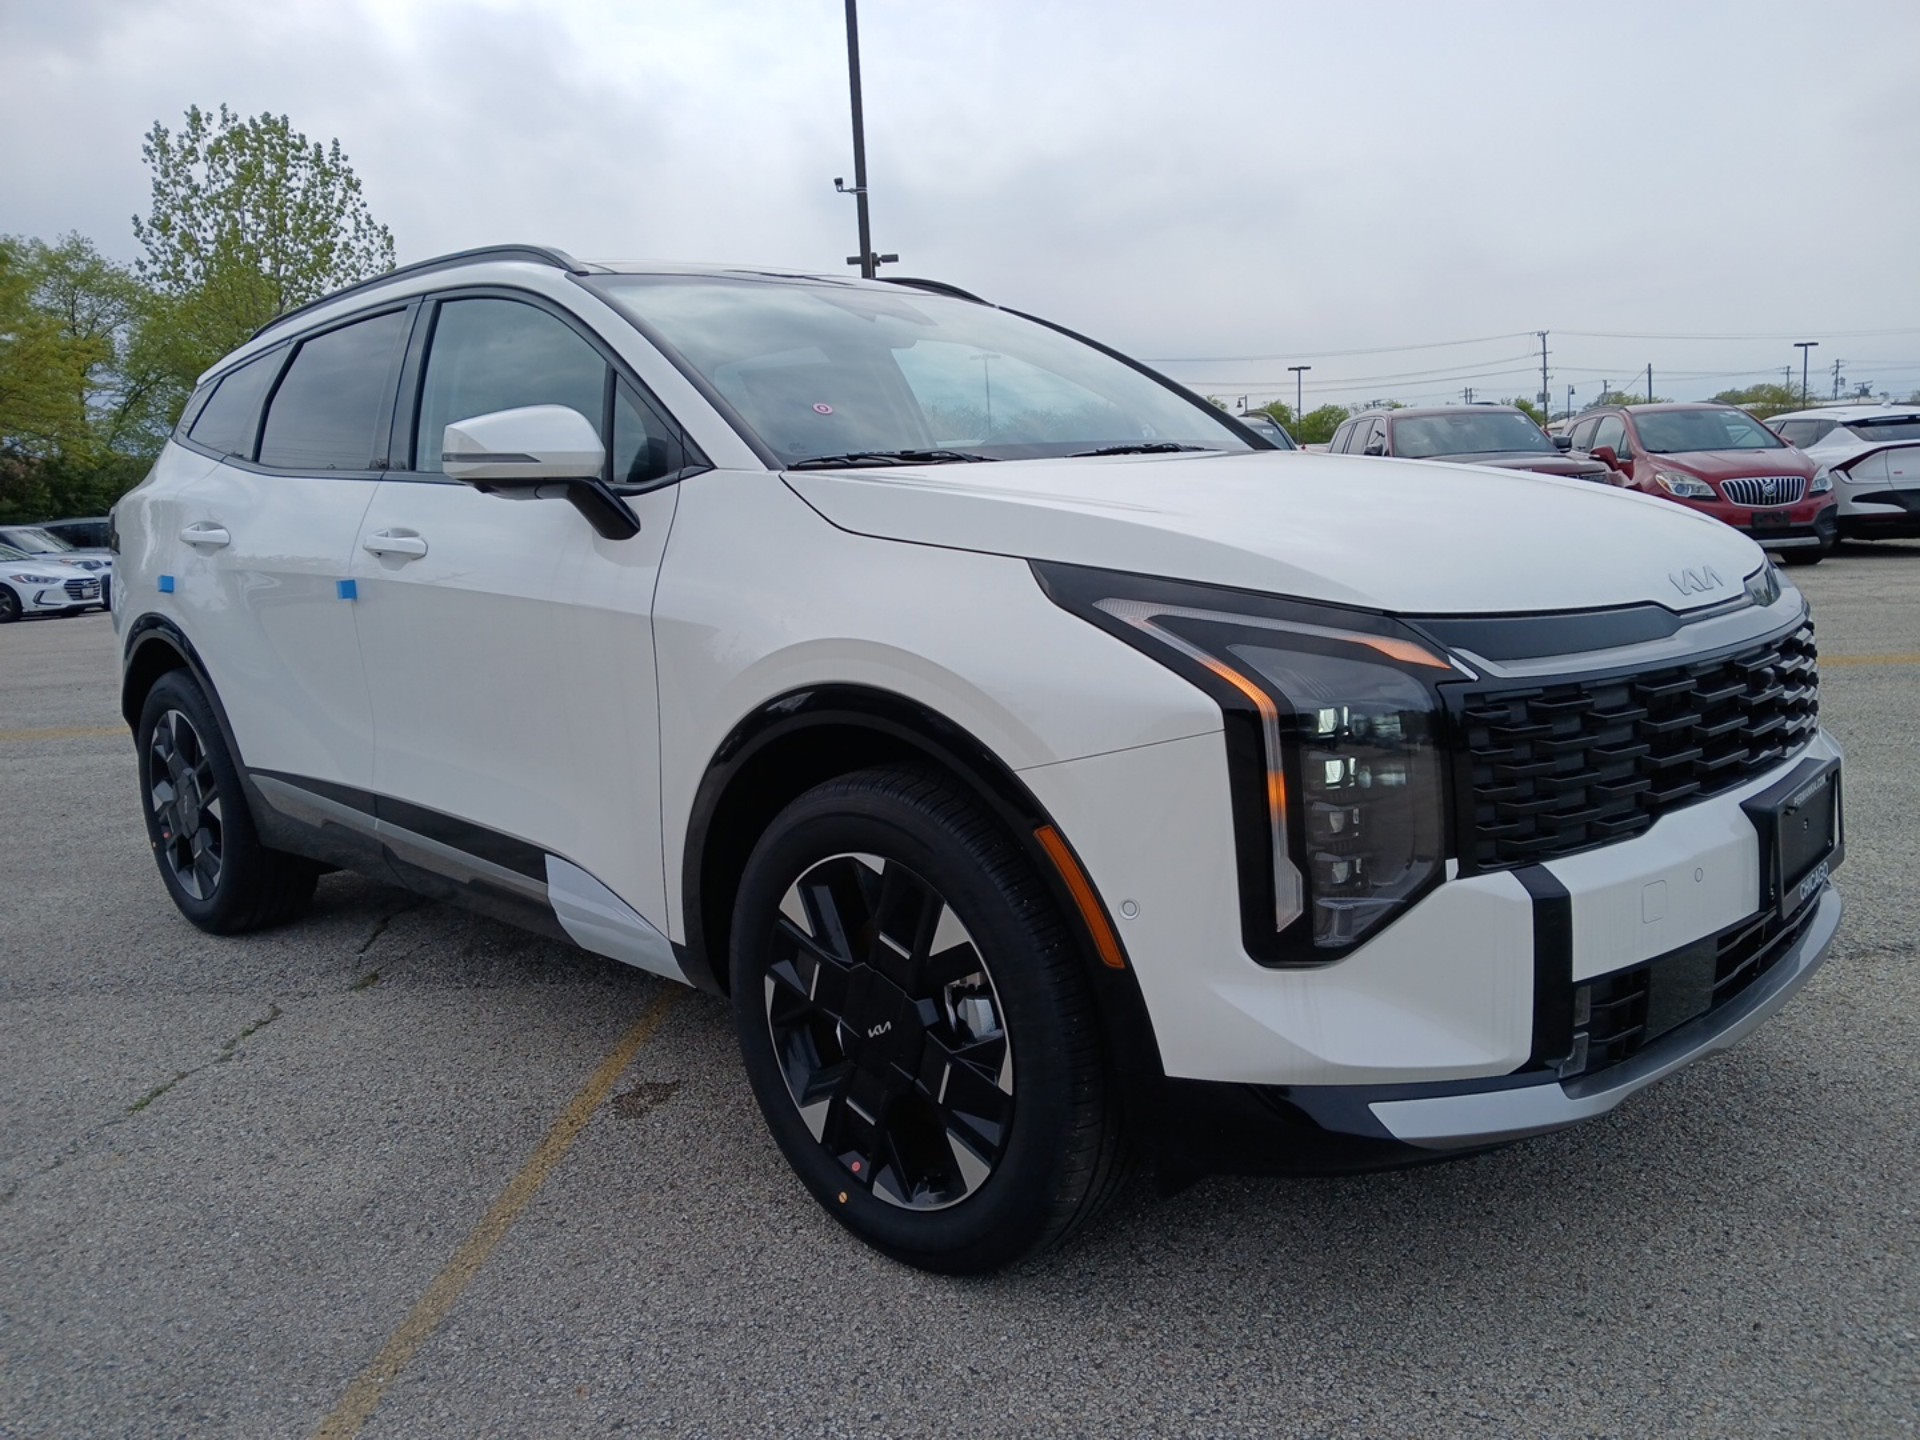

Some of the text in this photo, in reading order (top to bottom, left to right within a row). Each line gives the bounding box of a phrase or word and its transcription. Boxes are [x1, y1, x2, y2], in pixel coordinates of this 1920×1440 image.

[1668, 565, 1724, 596] KIA
[1799, 861, 1829, 900] CHICAGO
[867, 1020, 892, 1038] KIA
